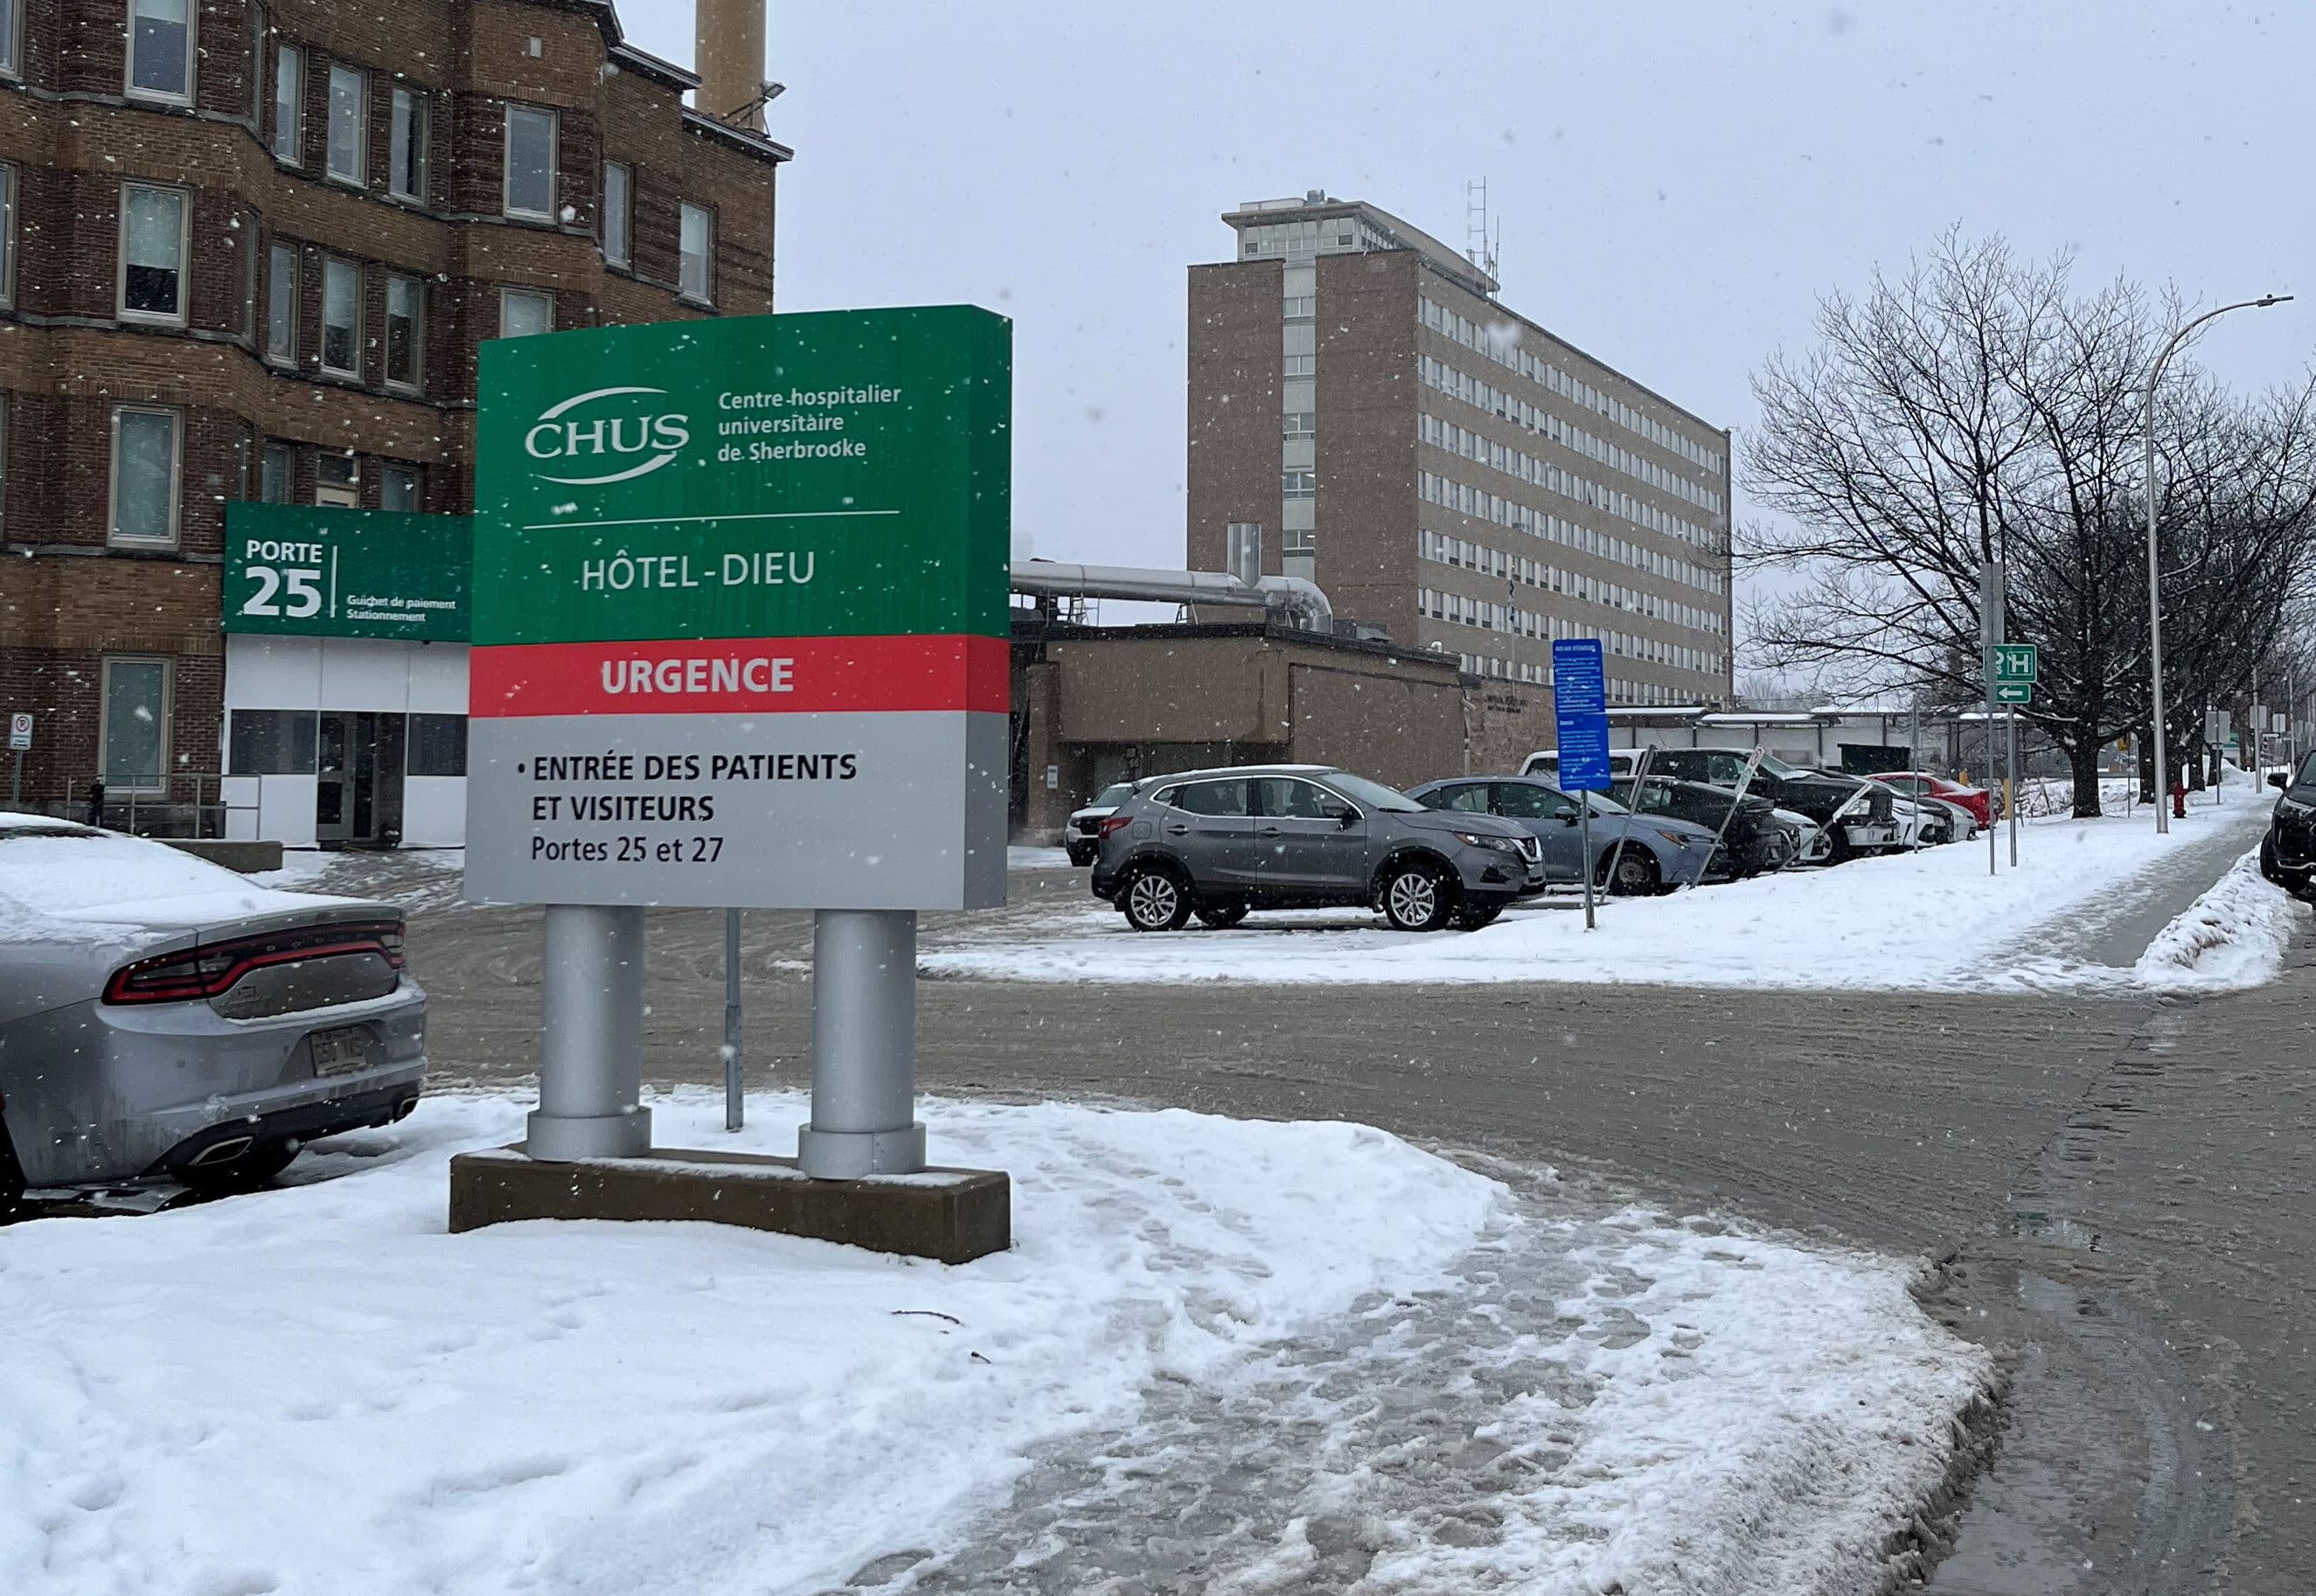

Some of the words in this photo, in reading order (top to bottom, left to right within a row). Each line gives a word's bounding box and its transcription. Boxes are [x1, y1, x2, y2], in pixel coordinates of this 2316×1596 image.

[719, 392, 783, 410] Centre
[790, 385, 901, 408] hospitalier
[525, 413, 690, 460] CHUS
[719, 414, 845, 435] universitaire
[718, 442, 741, 461] de
[749, 439, 866, 461] Sherbrooke
[246, 539, 323, 563] PORTE
[582, 549, 815, 591] HÔTEL-DIEU
[242, 566, 323, 618] 25
[346, 594, 389, 607] Guichet
[390, 596, 405, 607] de
[406, 597, 456, 611] paiement
[346, 607, 427, 622] Stationnement
[601, 657, 794, 694] URGENCE
[534, 750, 634, 781] ENTRÉE
[644, 754, 700, 781] DES
[711, 753, 857, 781] PATIENTS
[532, 795, 562, 821] ET
[570, 795, 714, 822] VISITEURS
[532, 836, 608, 862] Portes
[616, 836, 647, 862] 25
[657, 838, 683, 863] et
[692, 836, 724, 863] 27
